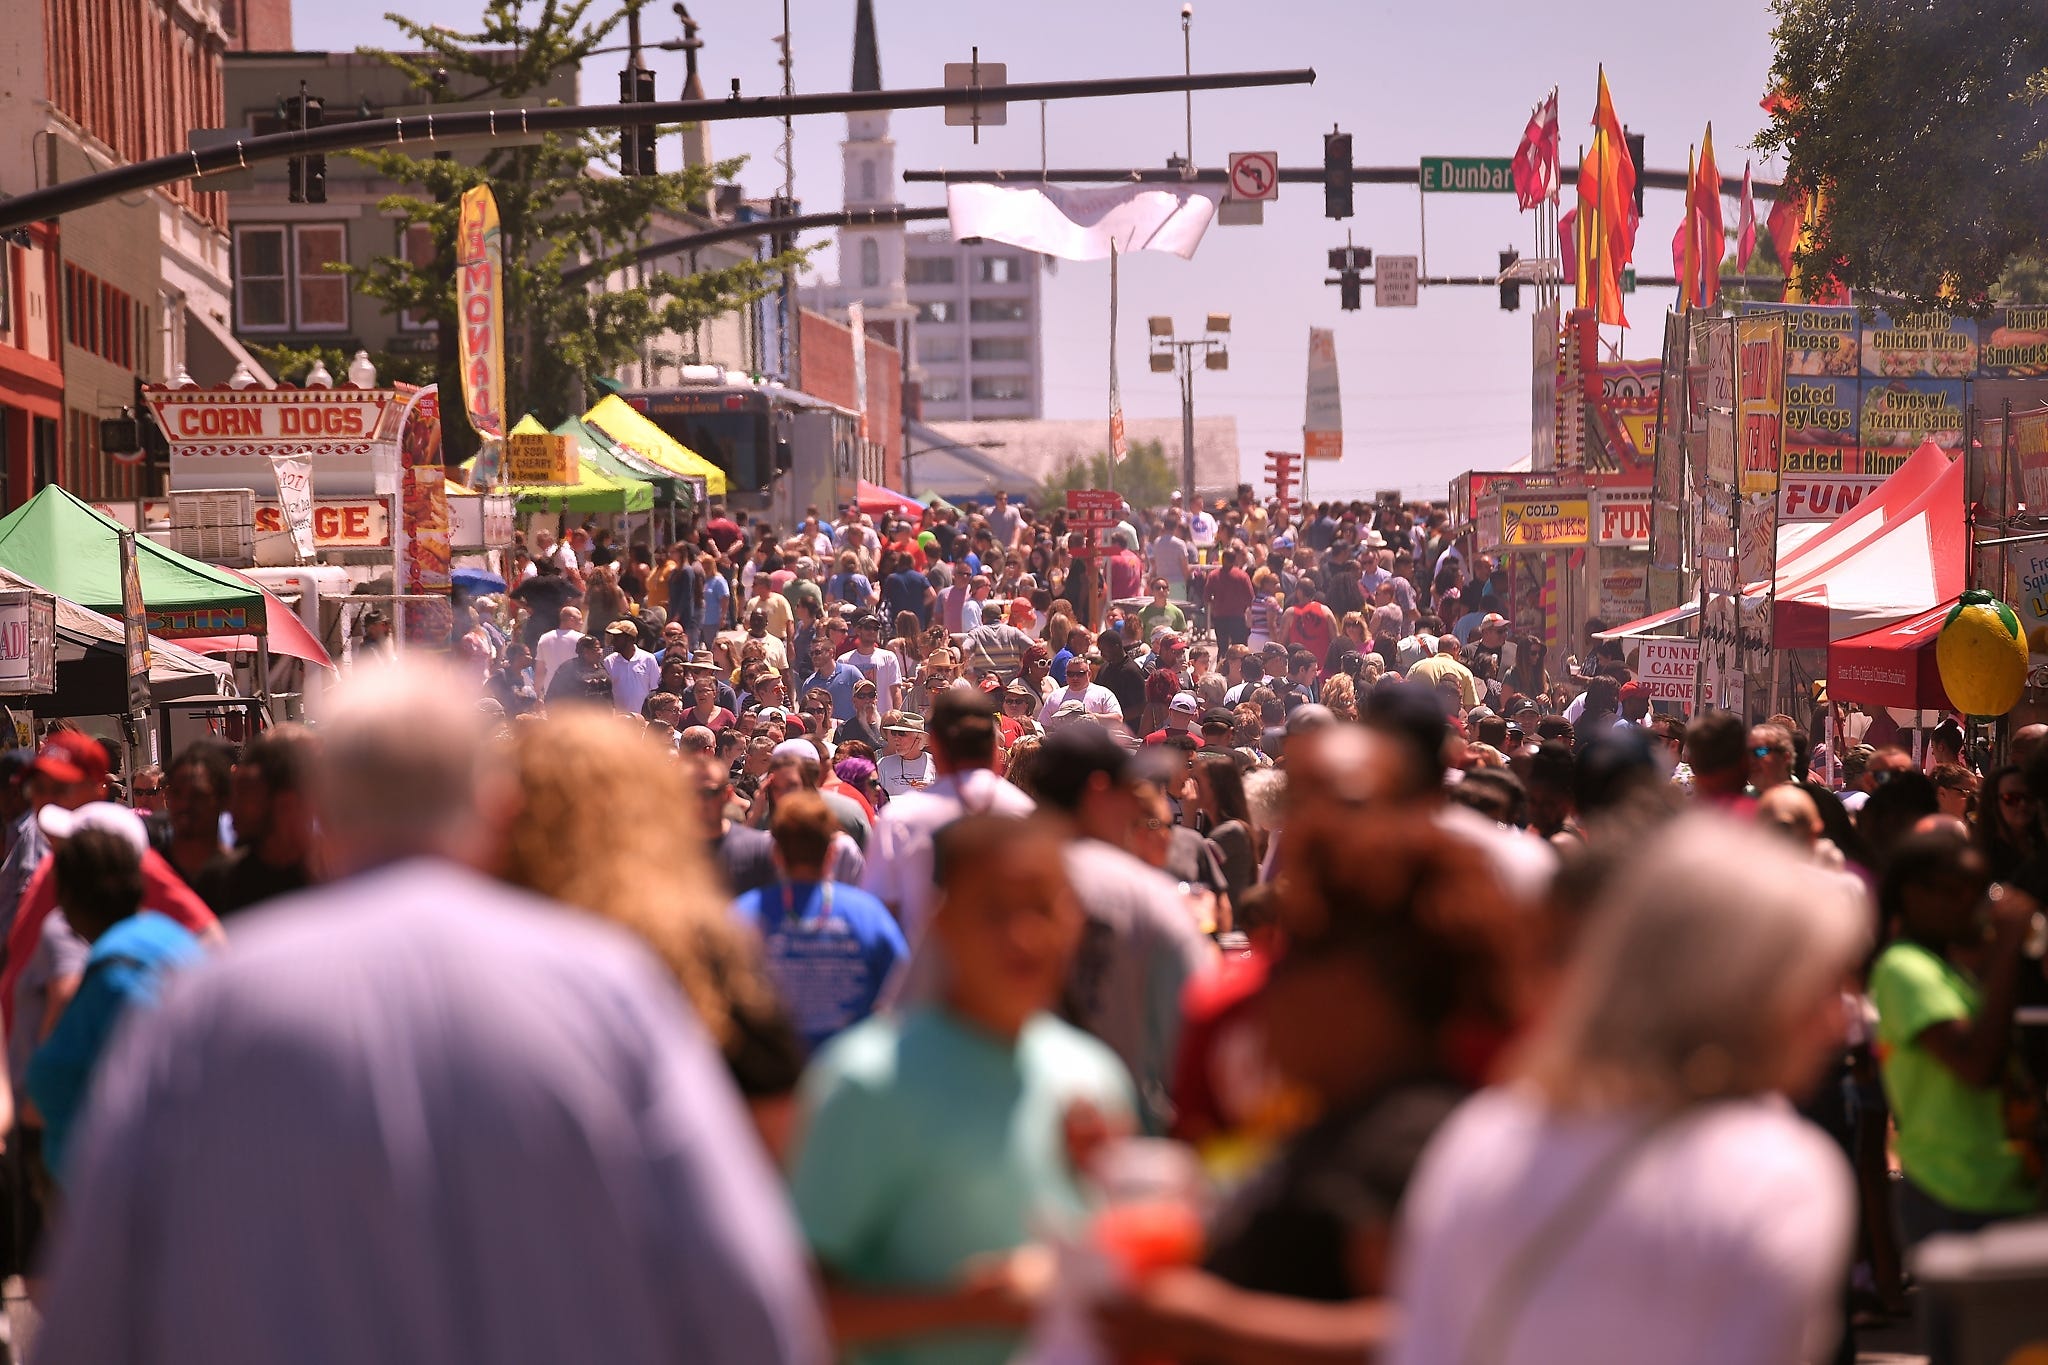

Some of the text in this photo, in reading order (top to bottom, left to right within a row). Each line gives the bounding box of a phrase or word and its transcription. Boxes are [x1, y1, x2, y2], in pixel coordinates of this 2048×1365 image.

[1423, 161, 1512, 189] E Dunbar
[1802, 310, 1853, 331] Steak
[2006, 309, 2048, 331] Bange
[1873, 329, 1967, 351] Chicken Wrap
[1987, 343, 2037, 366] Smoked
[1886, 390, 1925, 410] Gyros
[179, 407, 364, 436] CORN DOGS
[1809, 405, 1851, 431] Legs
[1869, 411, 1919, 429] Tzatziki
[1526, 504, 1560, 518] COLD
[1521, 516, 1587, 541] DRINKS
[1708, 558, 1733, 591] GYROS
